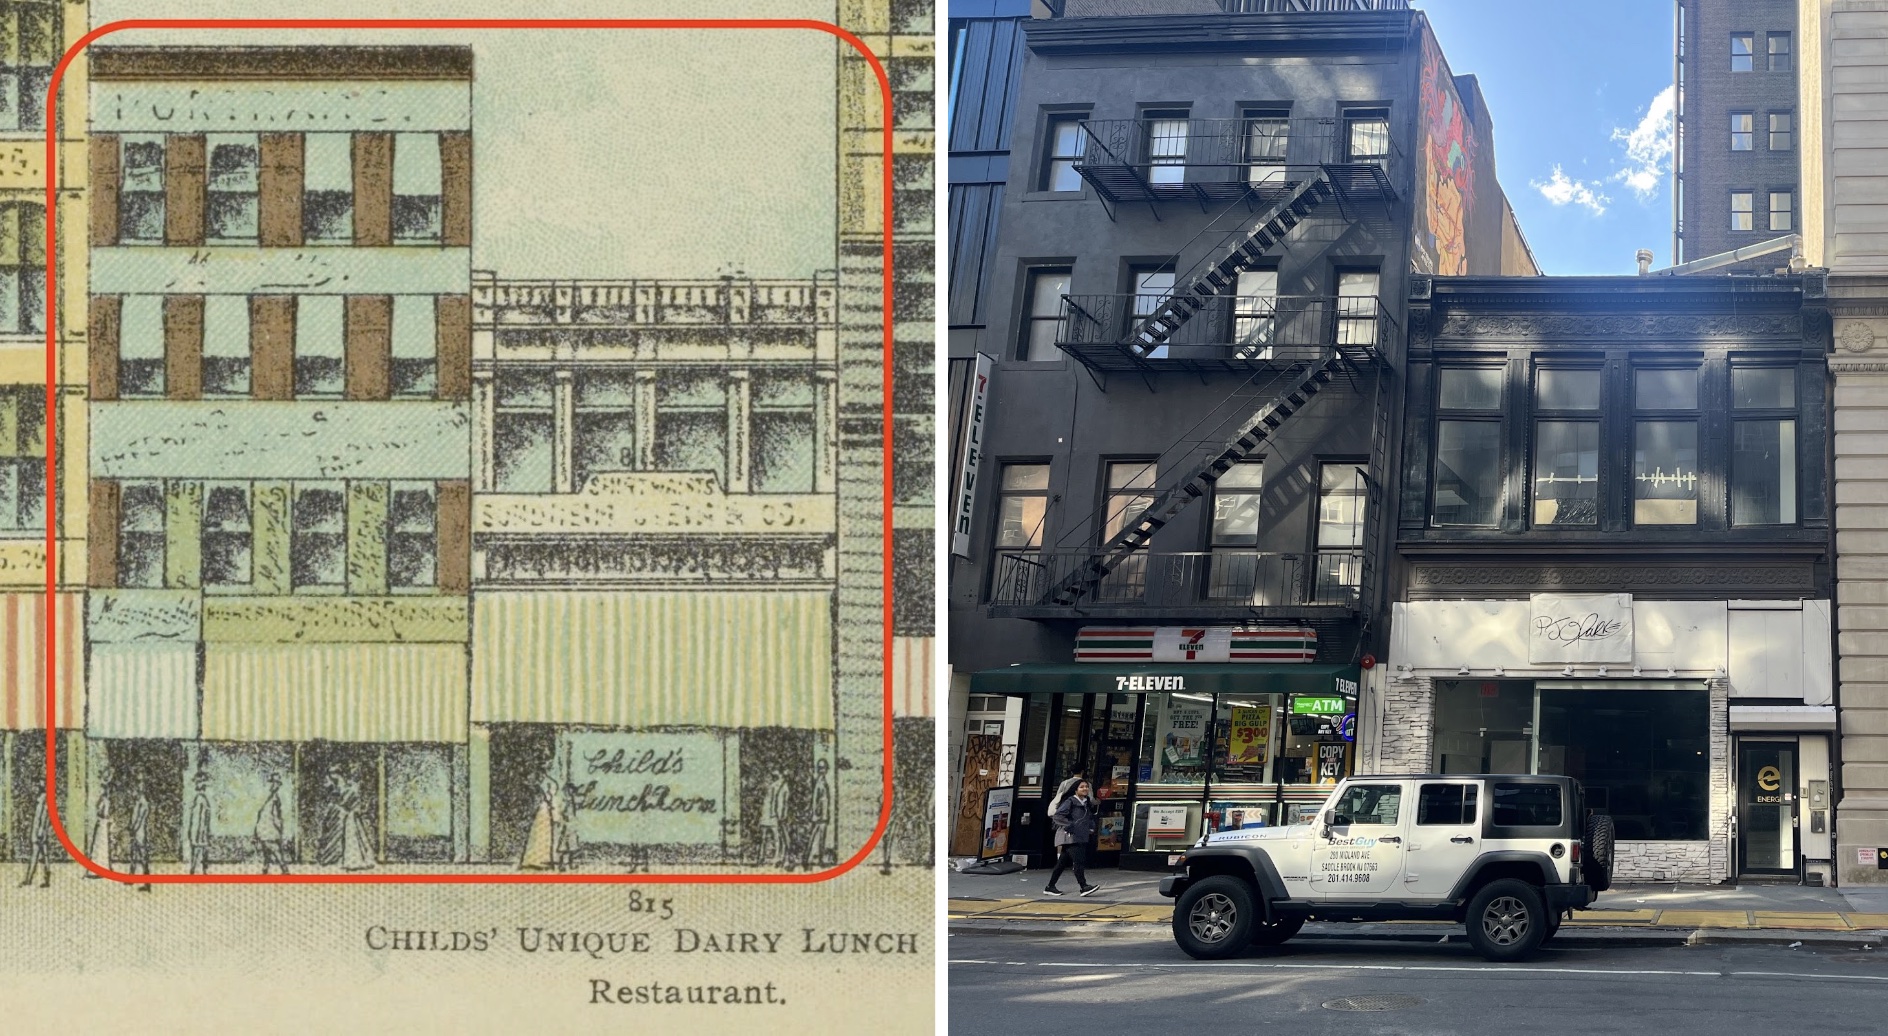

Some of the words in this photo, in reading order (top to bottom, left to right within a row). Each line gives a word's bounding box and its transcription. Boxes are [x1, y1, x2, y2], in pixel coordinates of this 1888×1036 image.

[1311, 699, 1343, 712] ATM
[1172, 720, 1199, 729] FREE!
[1320, 745, 1345, 759] COPY
[1320, 762, 1341, 776] KEY
[1321, 863, 1339, 871] SADDLE
[1340, 863, 1355, 871] BROOK
[1356, 863, 1363, 871] NJ
[628, 890, 674, 919] 815
[519, 927, 650, 958] UNIQUE
[673, 927, 783, 954] DAIRY
[801, 927, 918, 954] LUNCH
[589, 979, 787, 1005] Restaurant.
